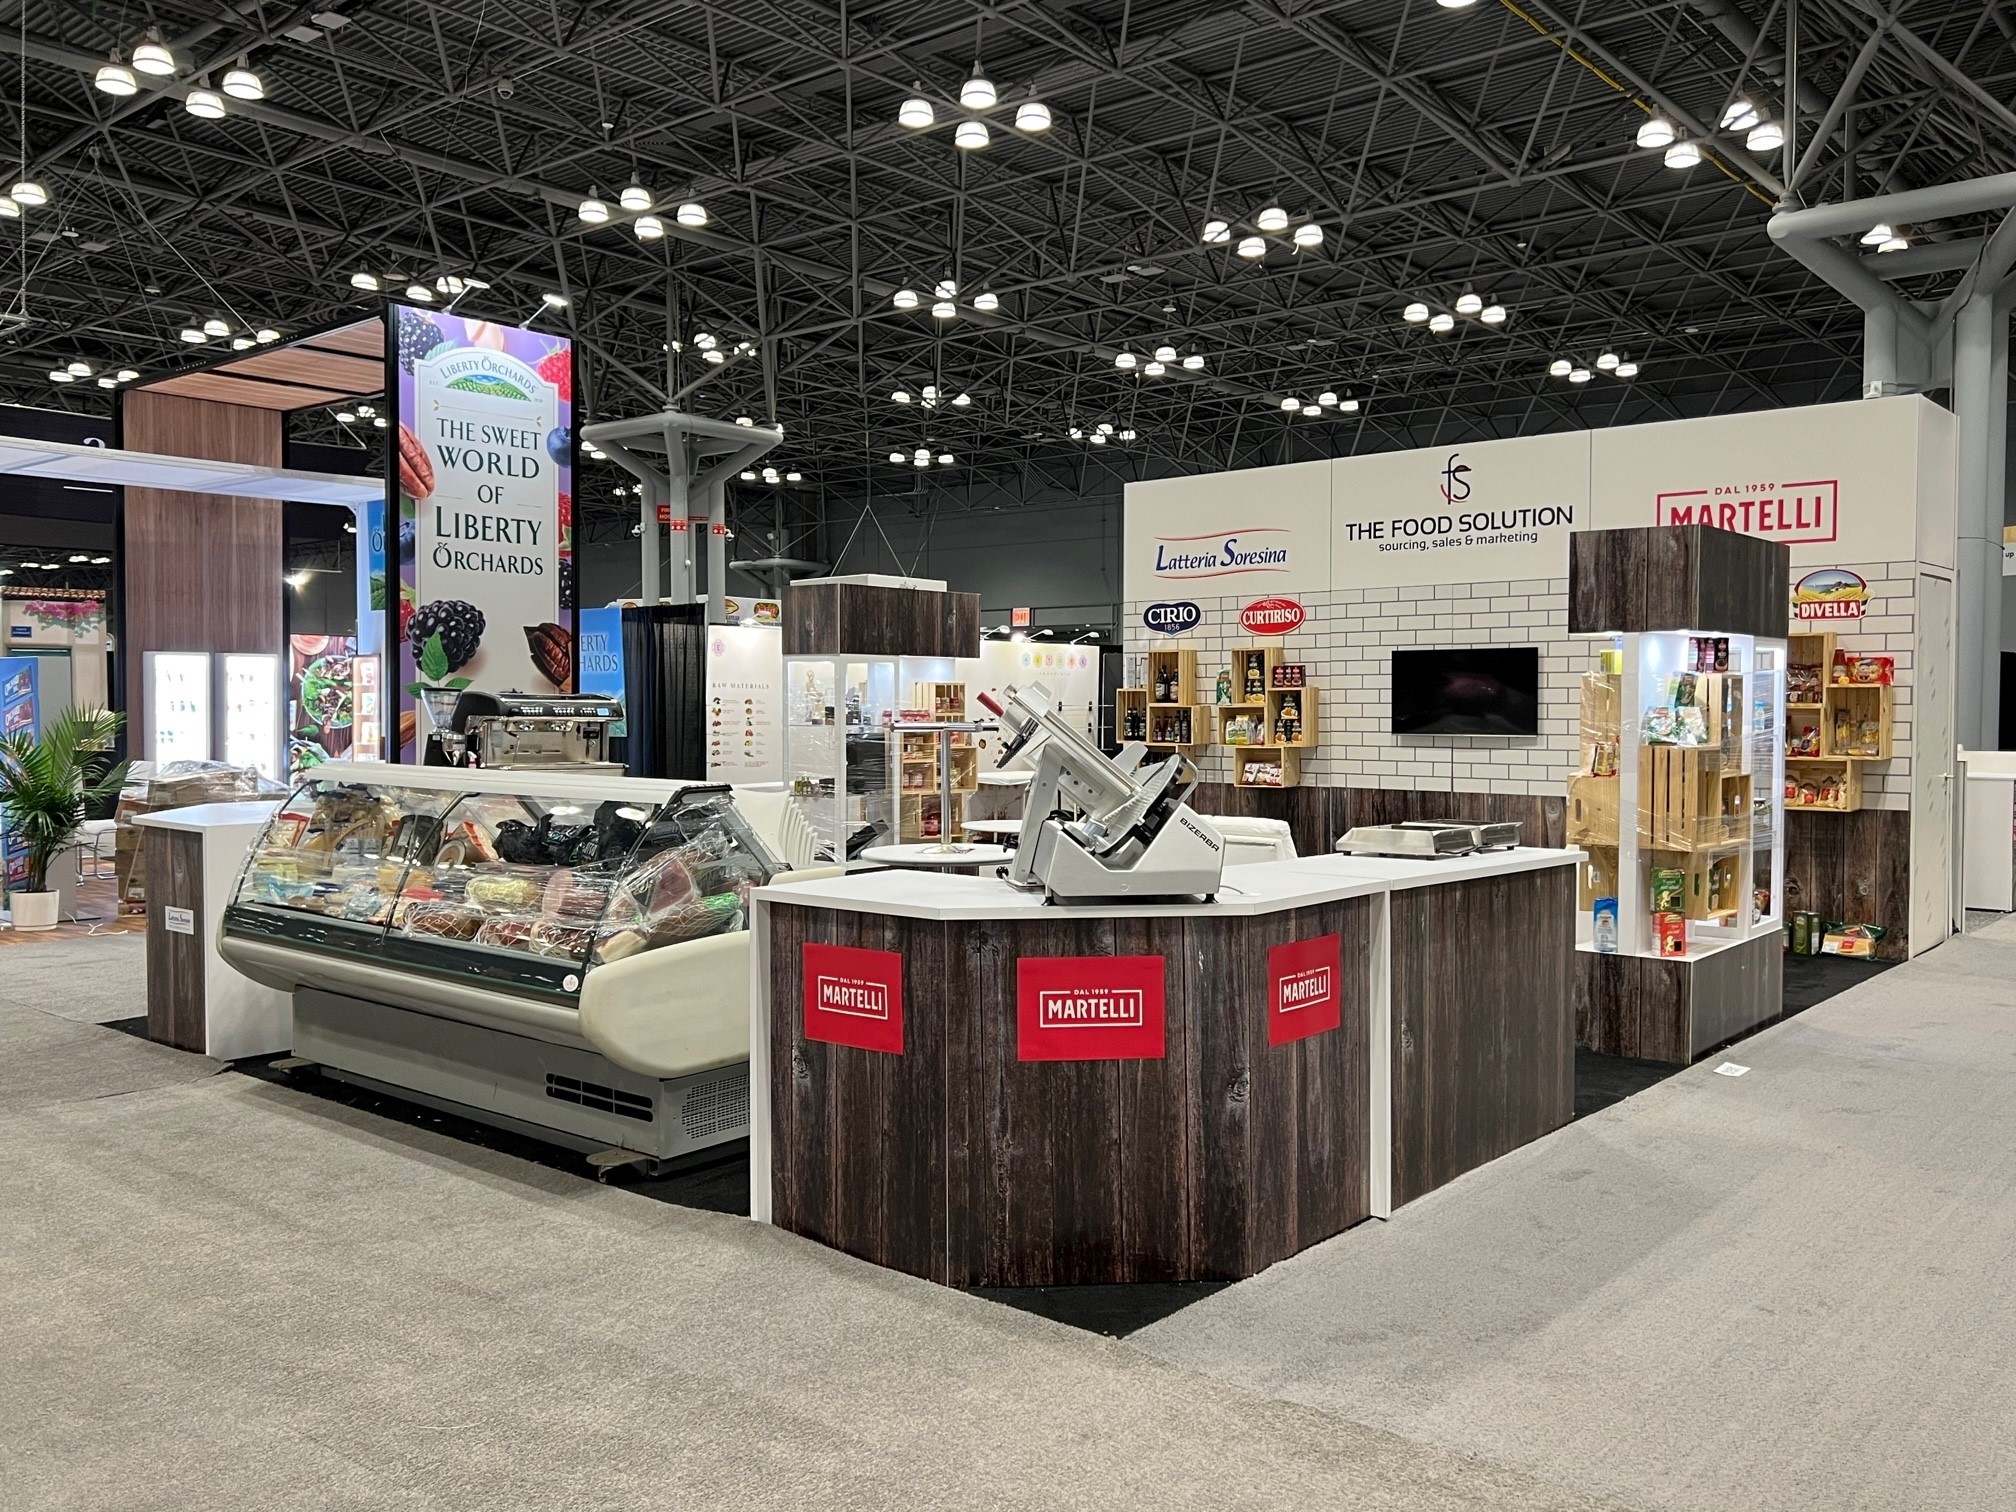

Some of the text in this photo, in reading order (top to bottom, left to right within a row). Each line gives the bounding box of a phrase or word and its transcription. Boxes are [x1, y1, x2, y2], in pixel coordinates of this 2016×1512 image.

[440, 360, 480, 379] LIBERTY
[436, 417, 542, 450] THE SWEET
[436, 444, 540, 479] WORLD
[477, 484, 504, 504] OF
[1715, 483, 1776, 495] DAL 1959
[1345, 505, 1574, 541] THE FOOD SOLUTION
[1670, 496, 1822, 533] MARTELLI
[436, 505, 542, 546] LIBERTY
[1378, 531, 1539, 552] sourcing, sales & marketing
[1155, 538, 1287, 571] Latteria Soresina
[1148, 606, 1197, 624] CIRIO
[1242, 607, 1301, 626] CURTIRISO
[1800, 602, 1859, 618] DIVELLA
[1164, 623, 1180, 631] 1856
[580, 634, 608, 652] ERTY
[1180, 817, 1220, 852] BIZERBA
[823, 984, 882, 1011] MARTELLI
[1283, 975, 1327, 1004] MARTELLI
[1048, 998, 1135, 1019] MARTELLI
